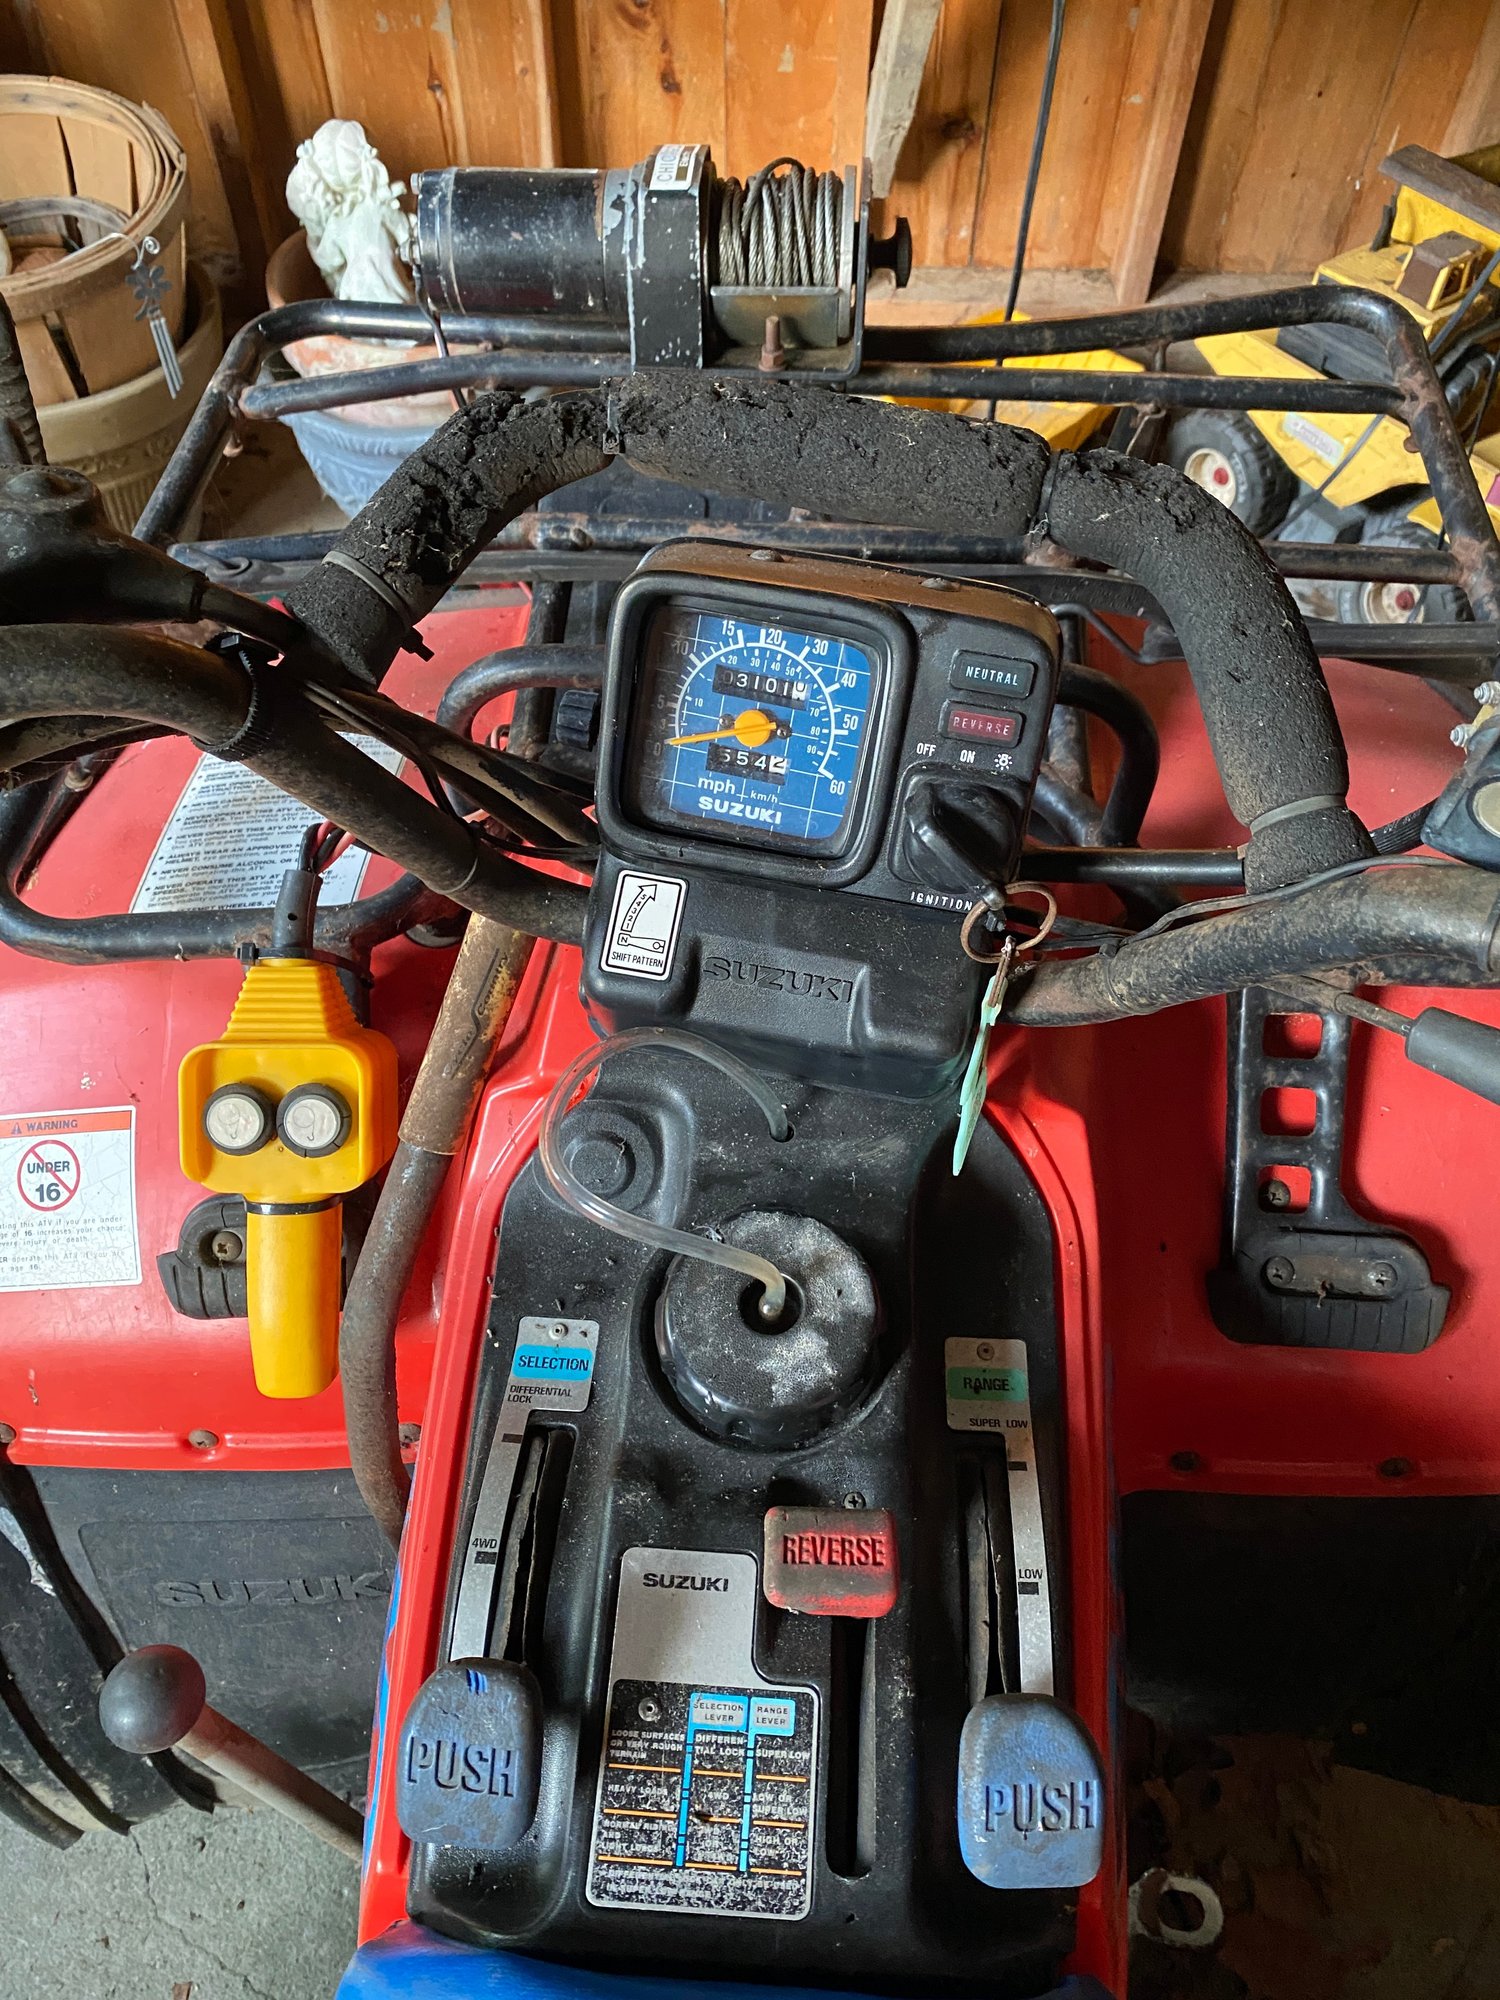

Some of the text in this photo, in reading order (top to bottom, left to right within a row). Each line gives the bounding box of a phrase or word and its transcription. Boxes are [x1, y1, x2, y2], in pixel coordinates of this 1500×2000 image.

[722, 620, 736, 636] 15
[766, 628, 782, 644] 20
[672, 640, 689, 655] 10
[812, 639, 828, 656] 30
[727, 655, 737, 665] 20
[750, 658, 760, 667] 30
[770, 662, 781, 671] 40
[785, 667, 795, 676] 50
[965, 666, 1018, 686] NEUTRAL
[841, 672, 857, 688] 40
[694, 698, 703, 707] 10
[810, 707, 819, 717] 70
[842, 714, 858, 730] 50
[953, 716, 1011, 736] REVERSE
[810, 726, 820, 736] 80
[807, 745, 817, 754] 90
[916, 742, 975, 763] OFF ON
[698, 777, 778, 804] mph km/h
[830, 780, 845, 796] 60
[698, 796, 782, 825] SUZUKI
[910, 892, 973, 911] IGNITION
[611, 952, 664, 968] SHIFT PATTERN
[702, 956, 853, 1003] SUZUKI
[26, 1120, 78, 1132] WARNING
[27, 1160, 70, 1174] UNDER
[35, 1182, 61, 1203] 16
[518, 1355, 590, 1372] SELECTION
[509, 1385, 573, 1397] DIFFERENTIAL
[963, 1377, 1010, 1392] RANGE
[507, 1393, 532, 1404] LOCK
[969, 1418, 1028, 1429] SUPER LOW
[472, 1538, 498, 1550] 4WD
[782, 1533, 885, 1568] REVERSE
[1018, 1569, 1043, 1580] LOW
[642, 1572, 729, 1593] SUZUKI
[693, 1702, 744, 1711] SELECTION
[757, 1706, 788, 1715] RANGE
[704, 1713, 734, 1722] LEVER
[756, 1717, 786, 1725] LEVER
[611, 1730, 685, 1741] LOOSE SURFACES
[652, 1742, 683, 1751] ROUGH
[694, 1746, 745, 1756] TIAL LOCK
[756, 1749, 810, 1760] SUPER LOW
[407, 1736, 520, 1798] PUSH
[608, 1784, 637, 1793] HEAVY
[985, 1779, 1099, 1834] PUSH
